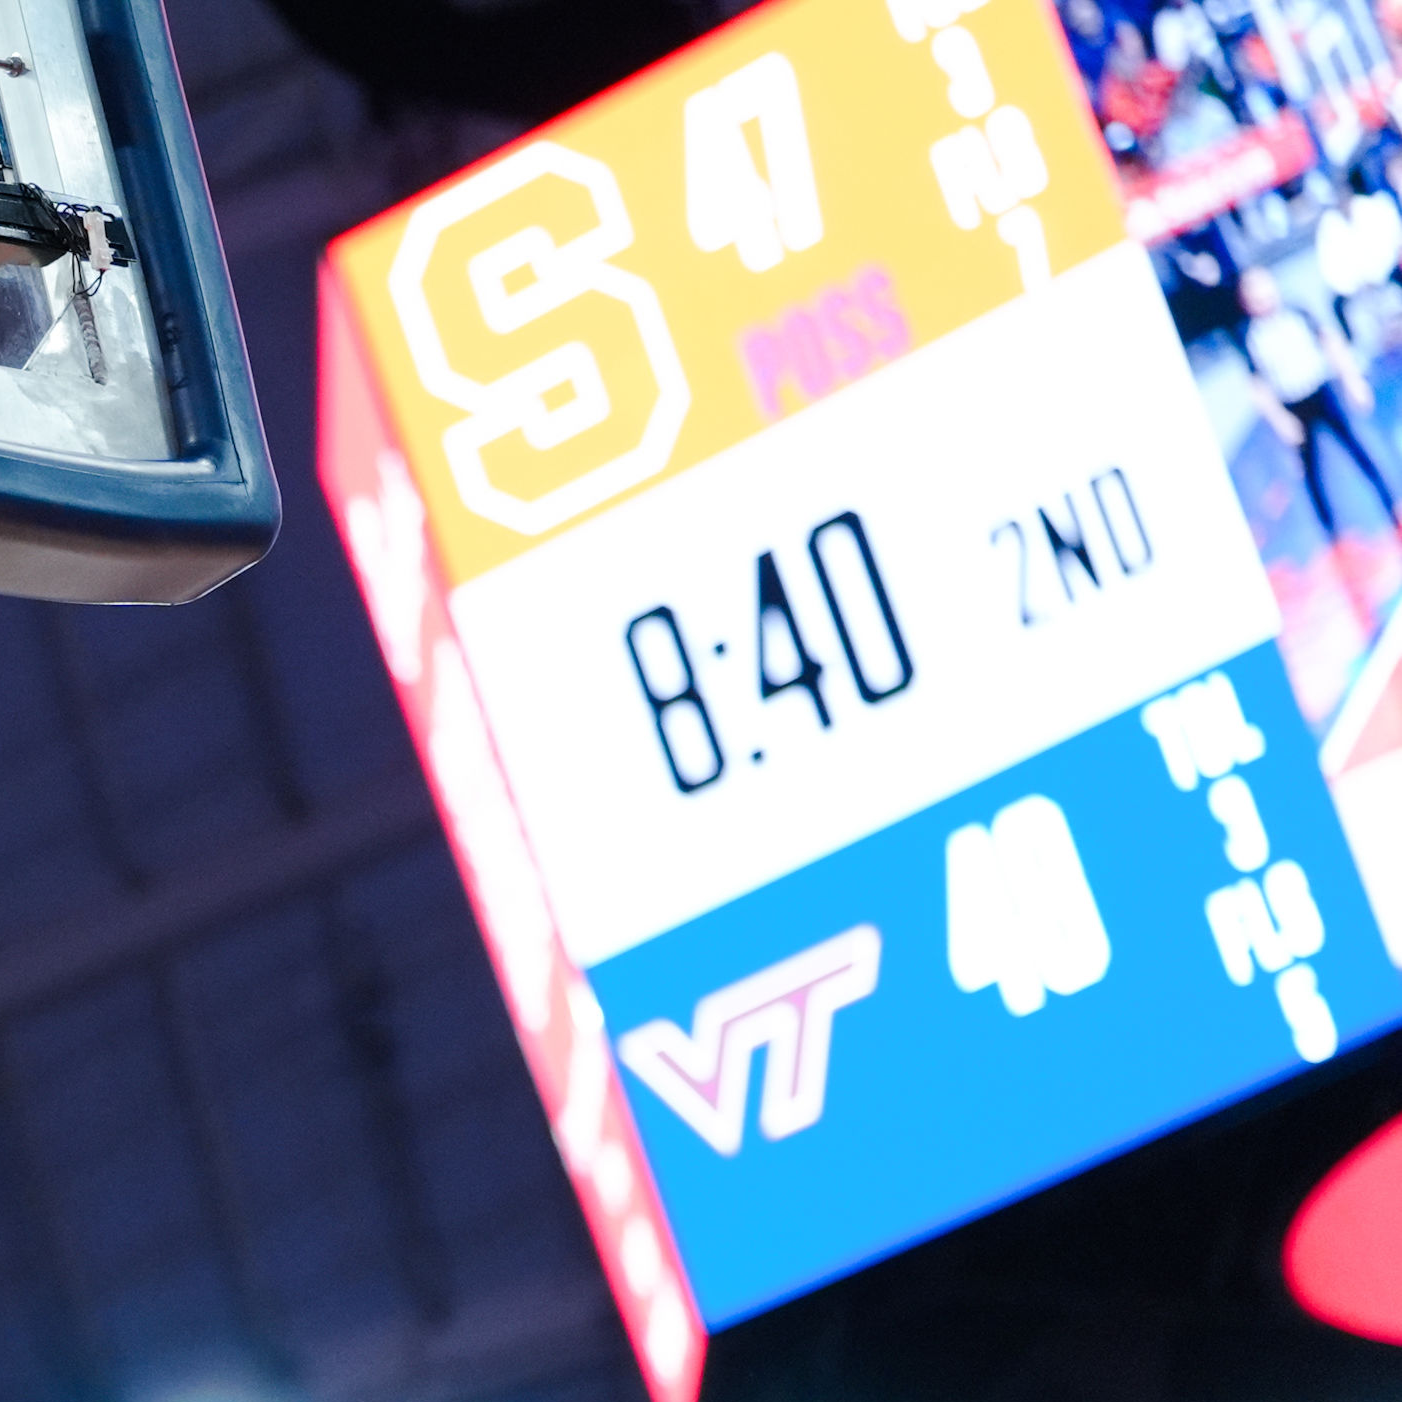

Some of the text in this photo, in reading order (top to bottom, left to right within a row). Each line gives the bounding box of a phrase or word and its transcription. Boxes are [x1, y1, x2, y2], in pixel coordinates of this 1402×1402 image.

[386, 139, 693, 538] S
[737, 262, 914, 421] POSS
[623, 510, 916, 797] 8:40
[988, 464, 1156, 631] 2ND
[620, 926, 882, 1154] VT
